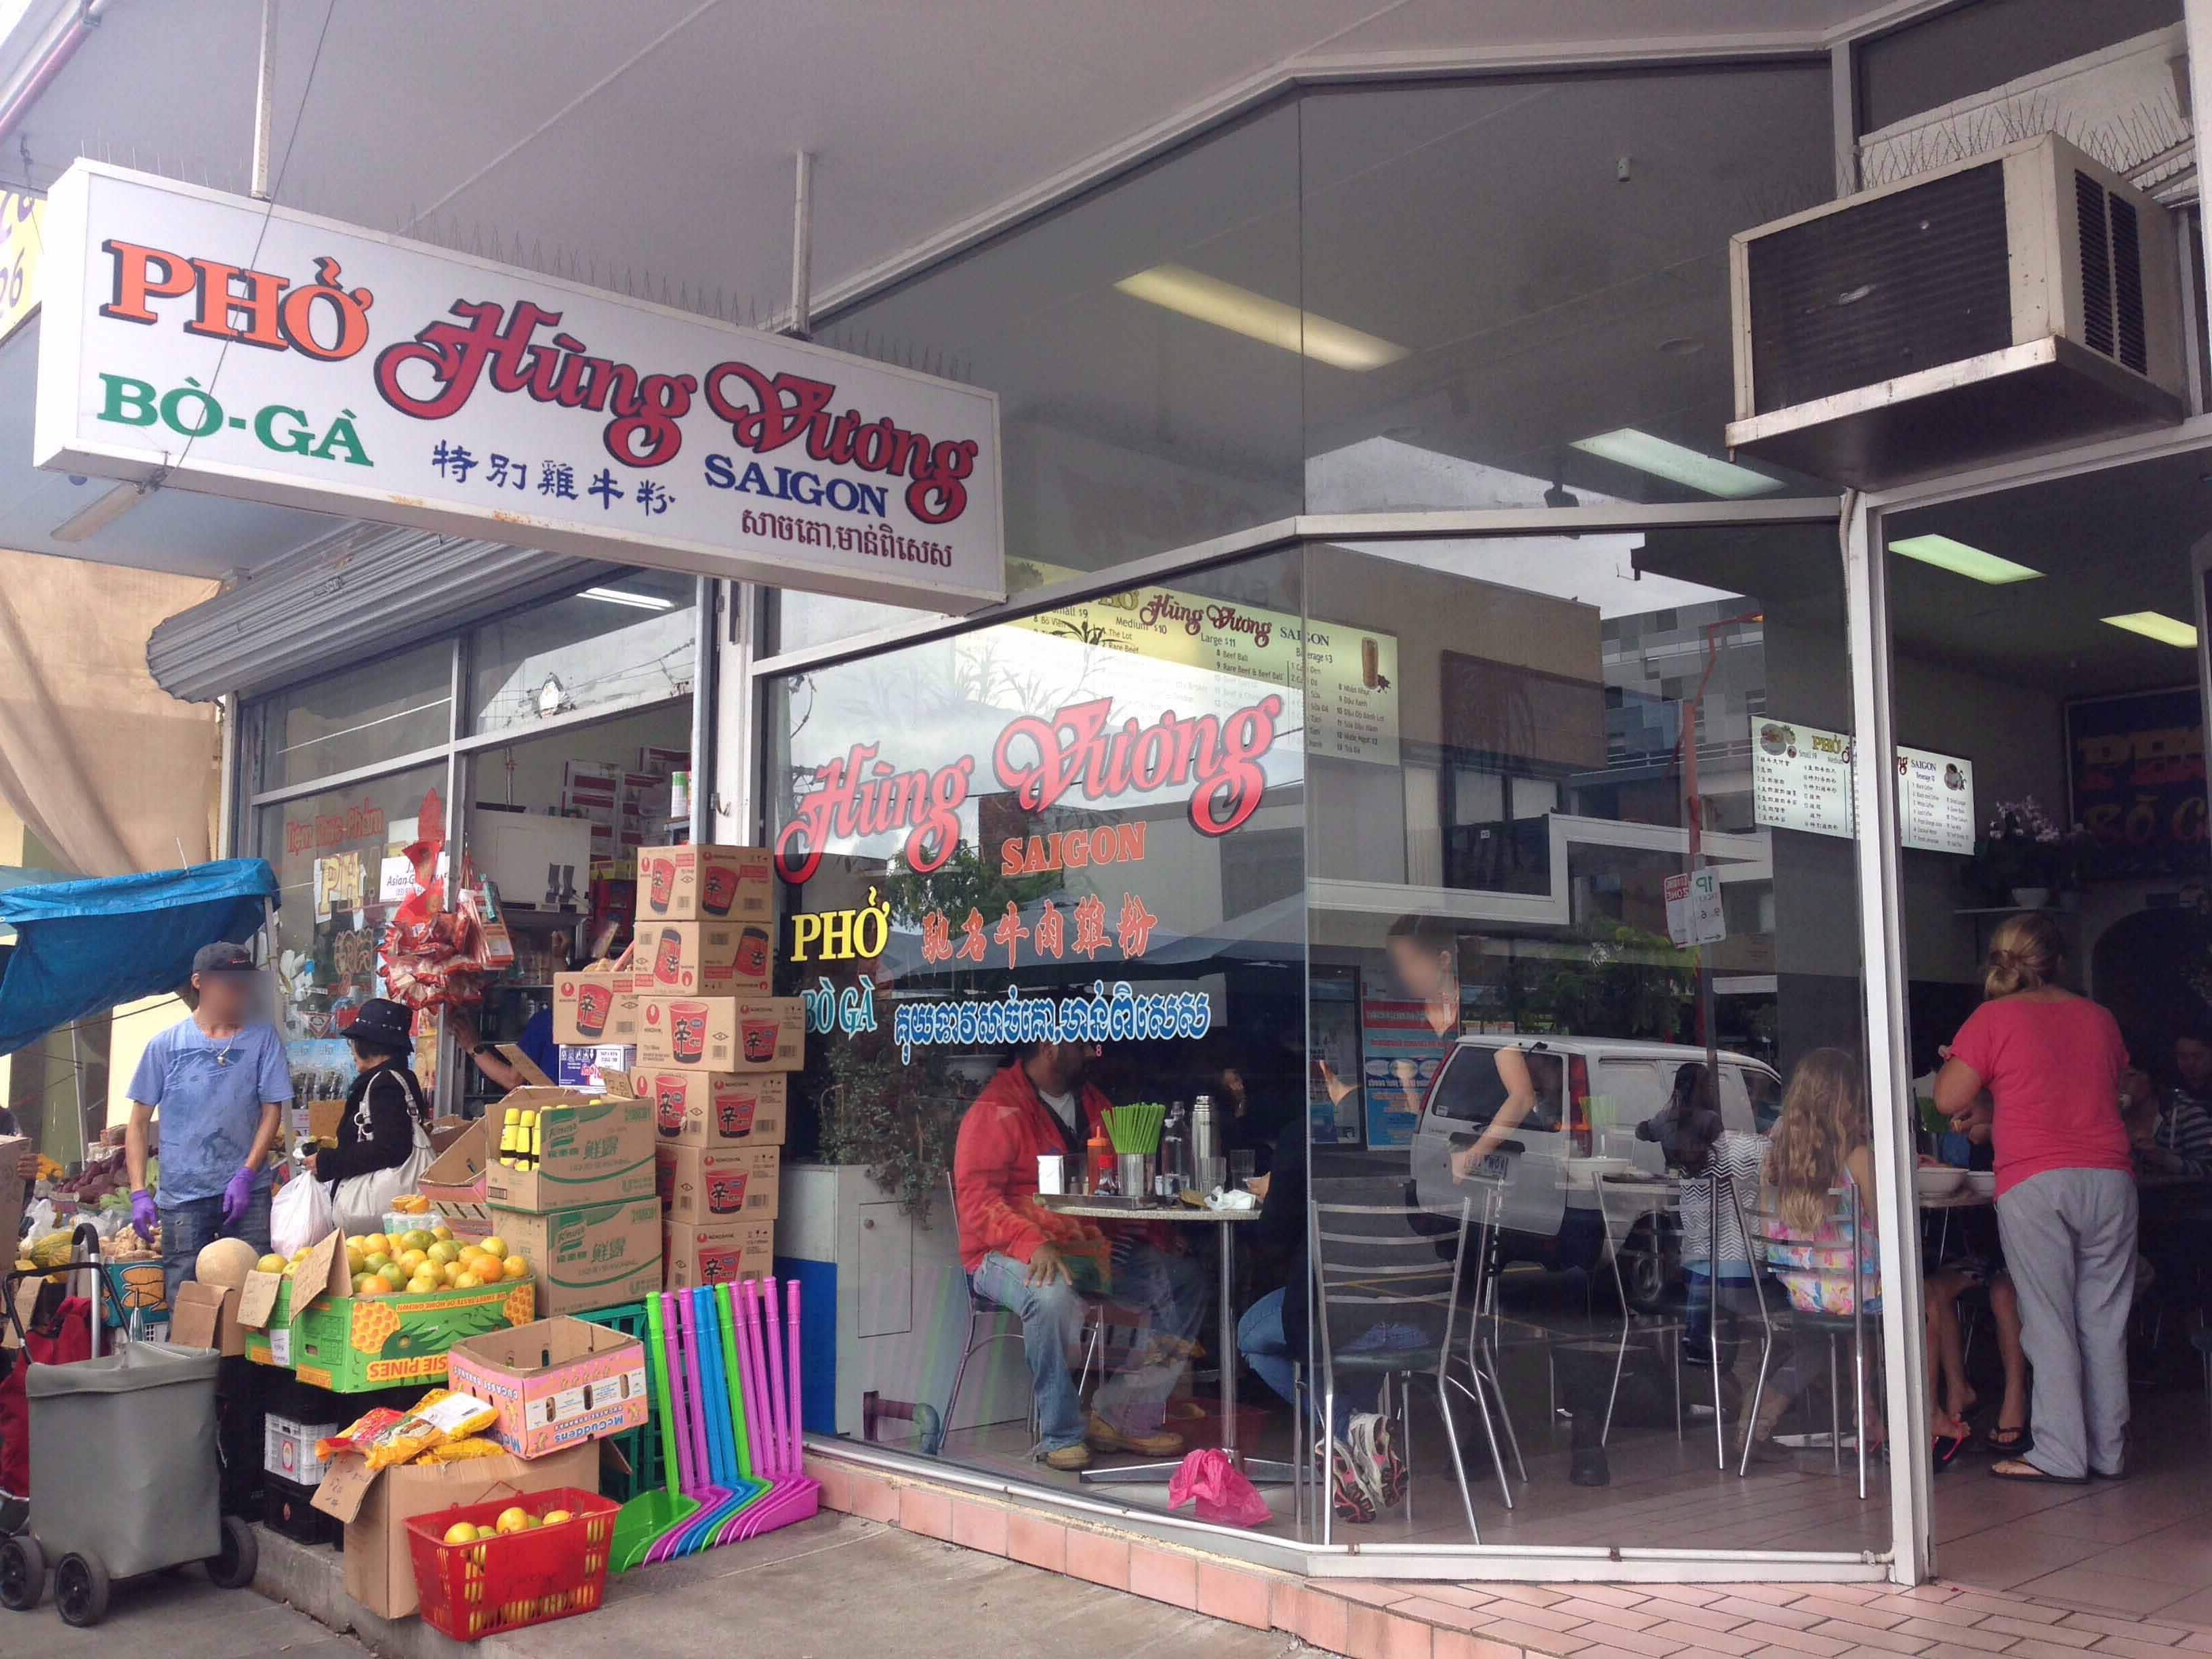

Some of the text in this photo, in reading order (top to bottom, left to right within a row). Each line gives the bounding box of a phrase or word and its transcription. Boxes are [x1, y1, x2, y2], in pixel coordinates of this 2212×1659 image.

[100, 239, 979, 525] PHỞ Hùng Vương
[98, 372, 373, 467] BÒ-GÀ
[704, 453, 888, 518] SAIGON
[1139, 593, 1204, 636] Hùng
[1206, 604, 1272, 648] Vương
[1201, 633, 1223, 646] Large
[1223, 650, 1236, 661] Beef
[1223, 663, 1237, 673] Rare
[1238, 665, 1252, 676] Beef
[775, 741, 975, 885] Hùng
[991, 693, 1283, 838] Vương
[1911, 759, 1936, 771] SAIGON
[1001, 821, 1147, 876] SAIGON
[386, 875, 407, 886] Asian
[790, 886, 890, 962] PHỞ
[839, 975, 878, 1041] GÀ
[369, 1358, 419, 1378] PINES
